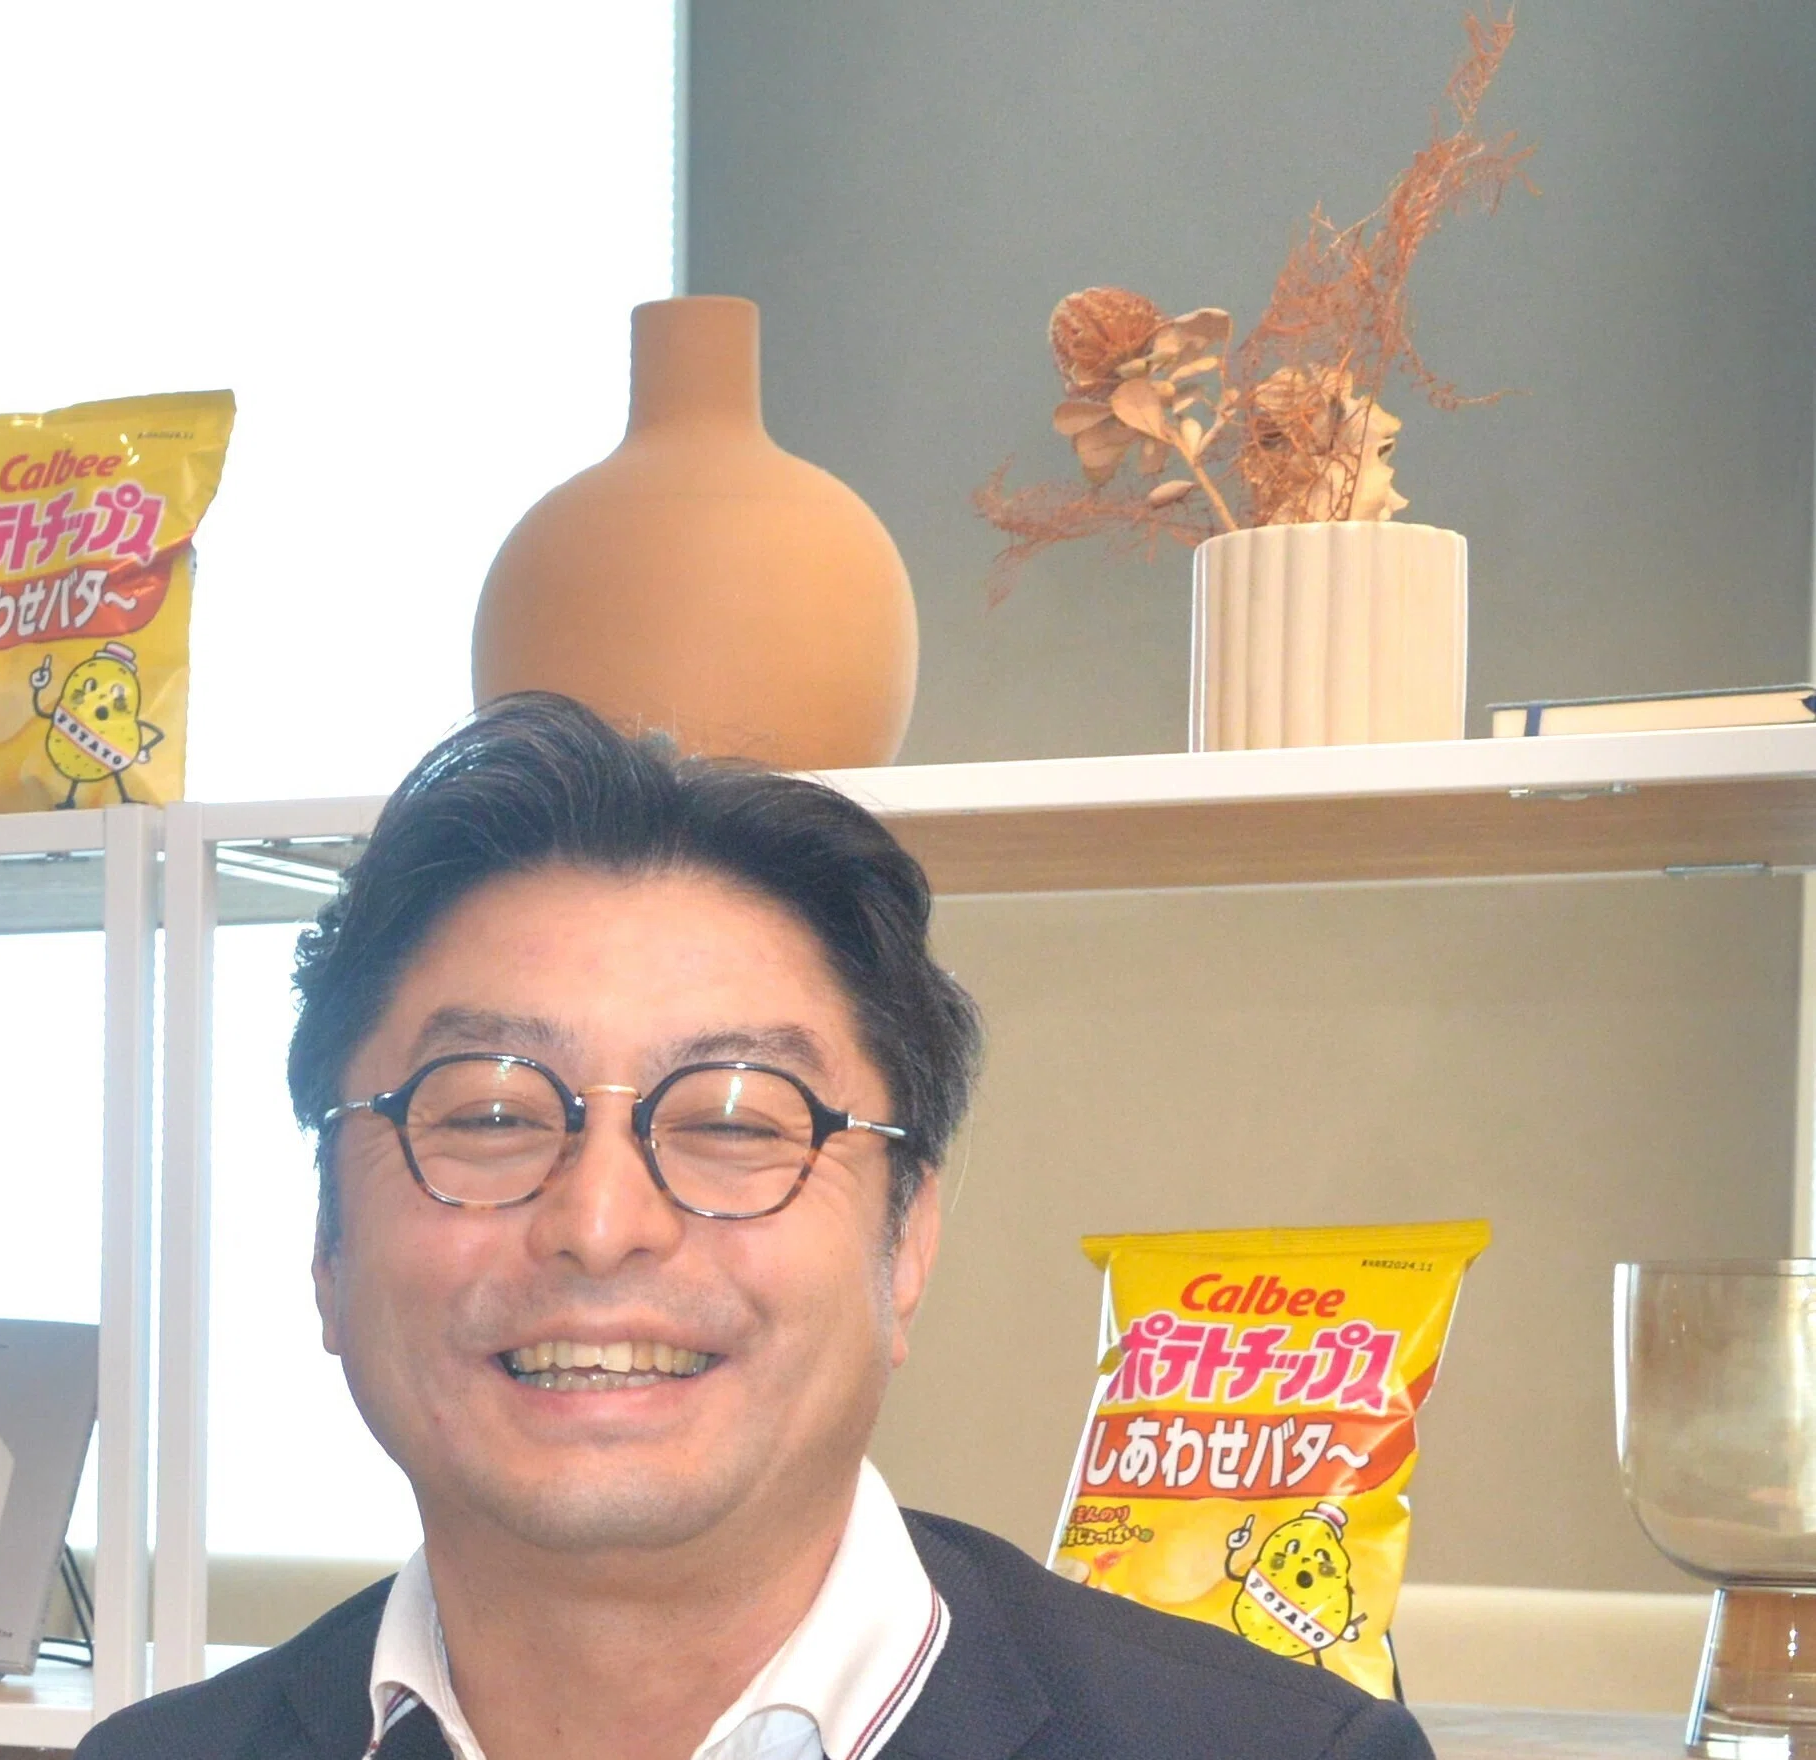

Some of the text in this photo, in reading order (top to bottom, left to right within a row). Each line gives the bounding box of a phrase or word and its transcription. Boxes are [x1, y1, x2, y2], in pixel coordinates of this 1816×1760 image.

[55, 713, 124, 767] POTATO
[1180, 1273, 1346, 1318] Calbee
[1105, 1312, 1399, 1413] ポテトチップス
[1085, 1417, 1370, 1491] しあわせバタ〜
[1249, 1576, 1327, 1644] POTATO
